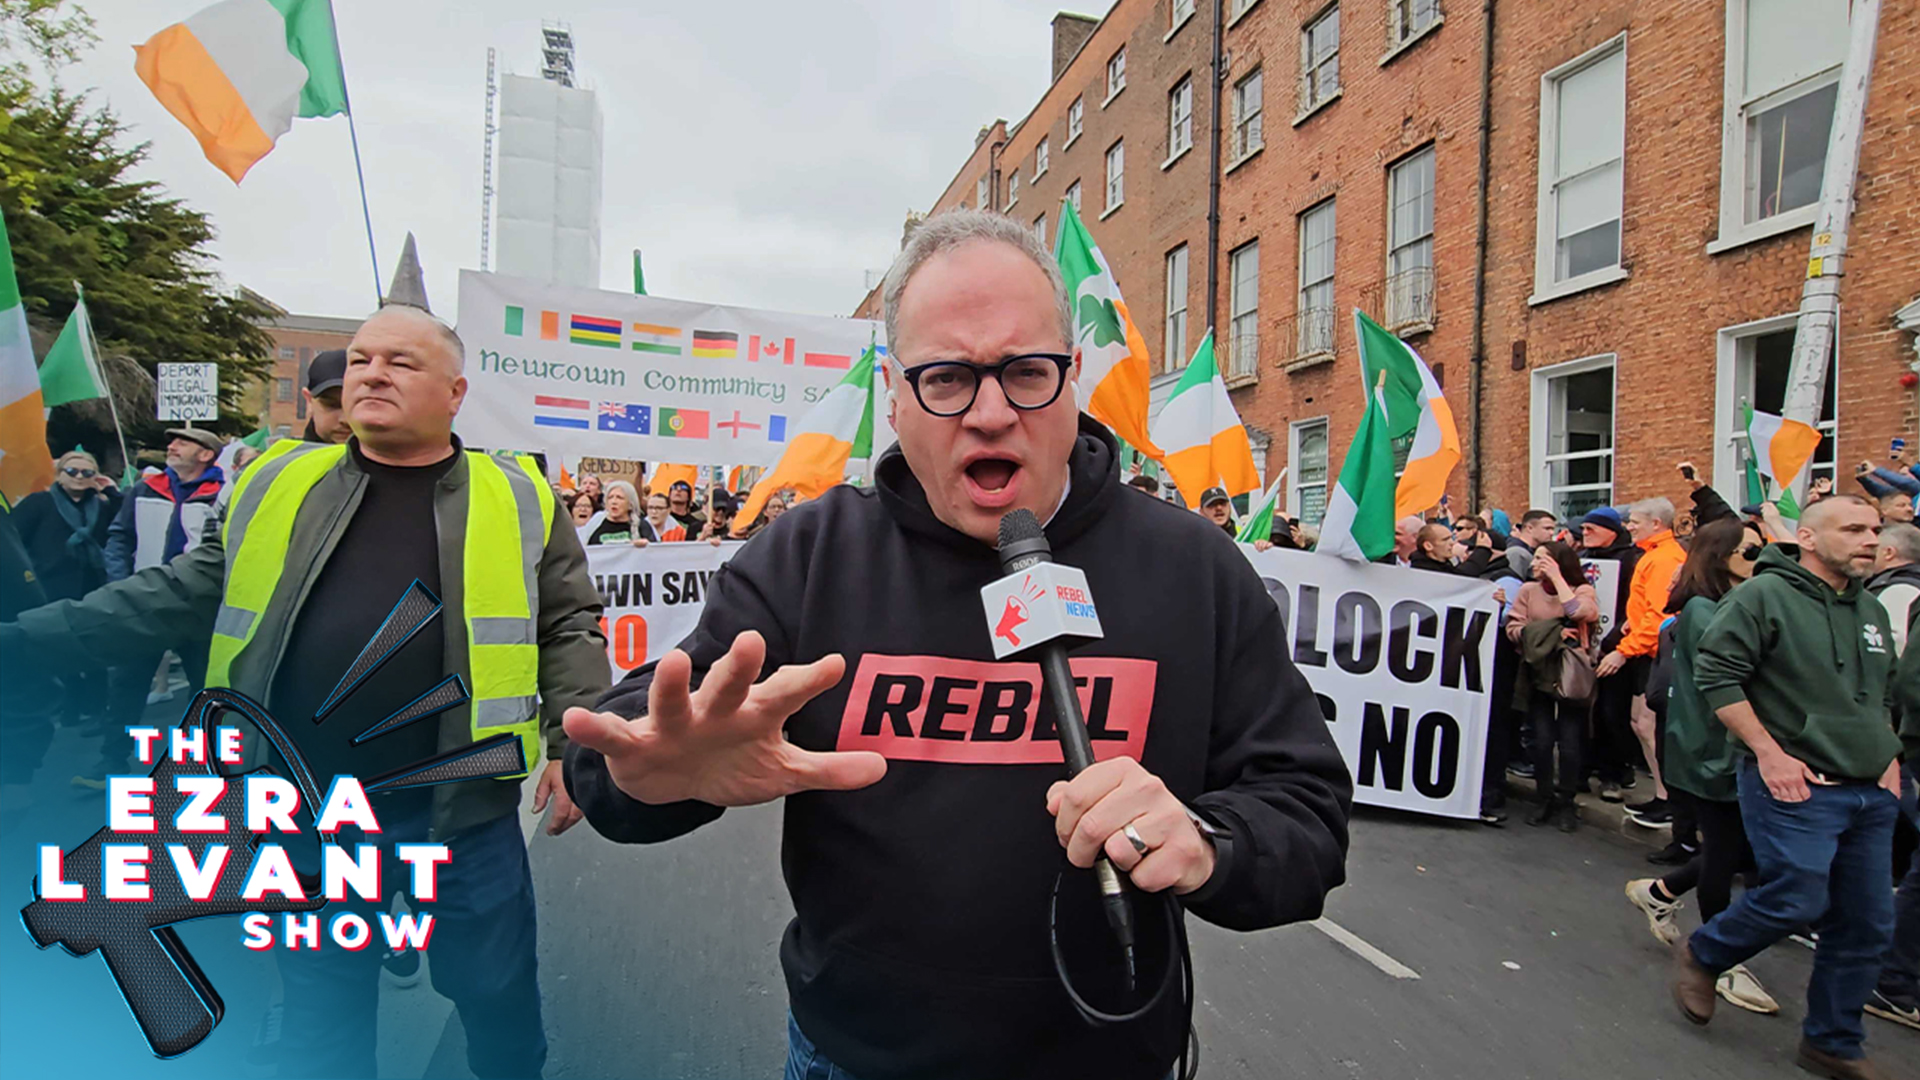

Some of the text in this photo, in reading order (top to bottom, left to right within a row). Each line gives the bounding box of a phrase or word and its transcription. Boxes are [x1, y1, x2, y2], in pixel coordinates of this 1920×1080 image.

[159, 364, 210, 378] DEPORT
[480, 349, 626, 386] Newtown
[643, 370, 786, 404] Community
[160, 379, 209, 393] ILLEGAL
[160, 394, 217, 407] IMMIGRANTS
[170, 407, 209, 420] NOW
[1056, 585, 1088, 604] REBEL
[1065, 602, 1096, 619] NEWS
[1357, 701, 1461, 800] NO
